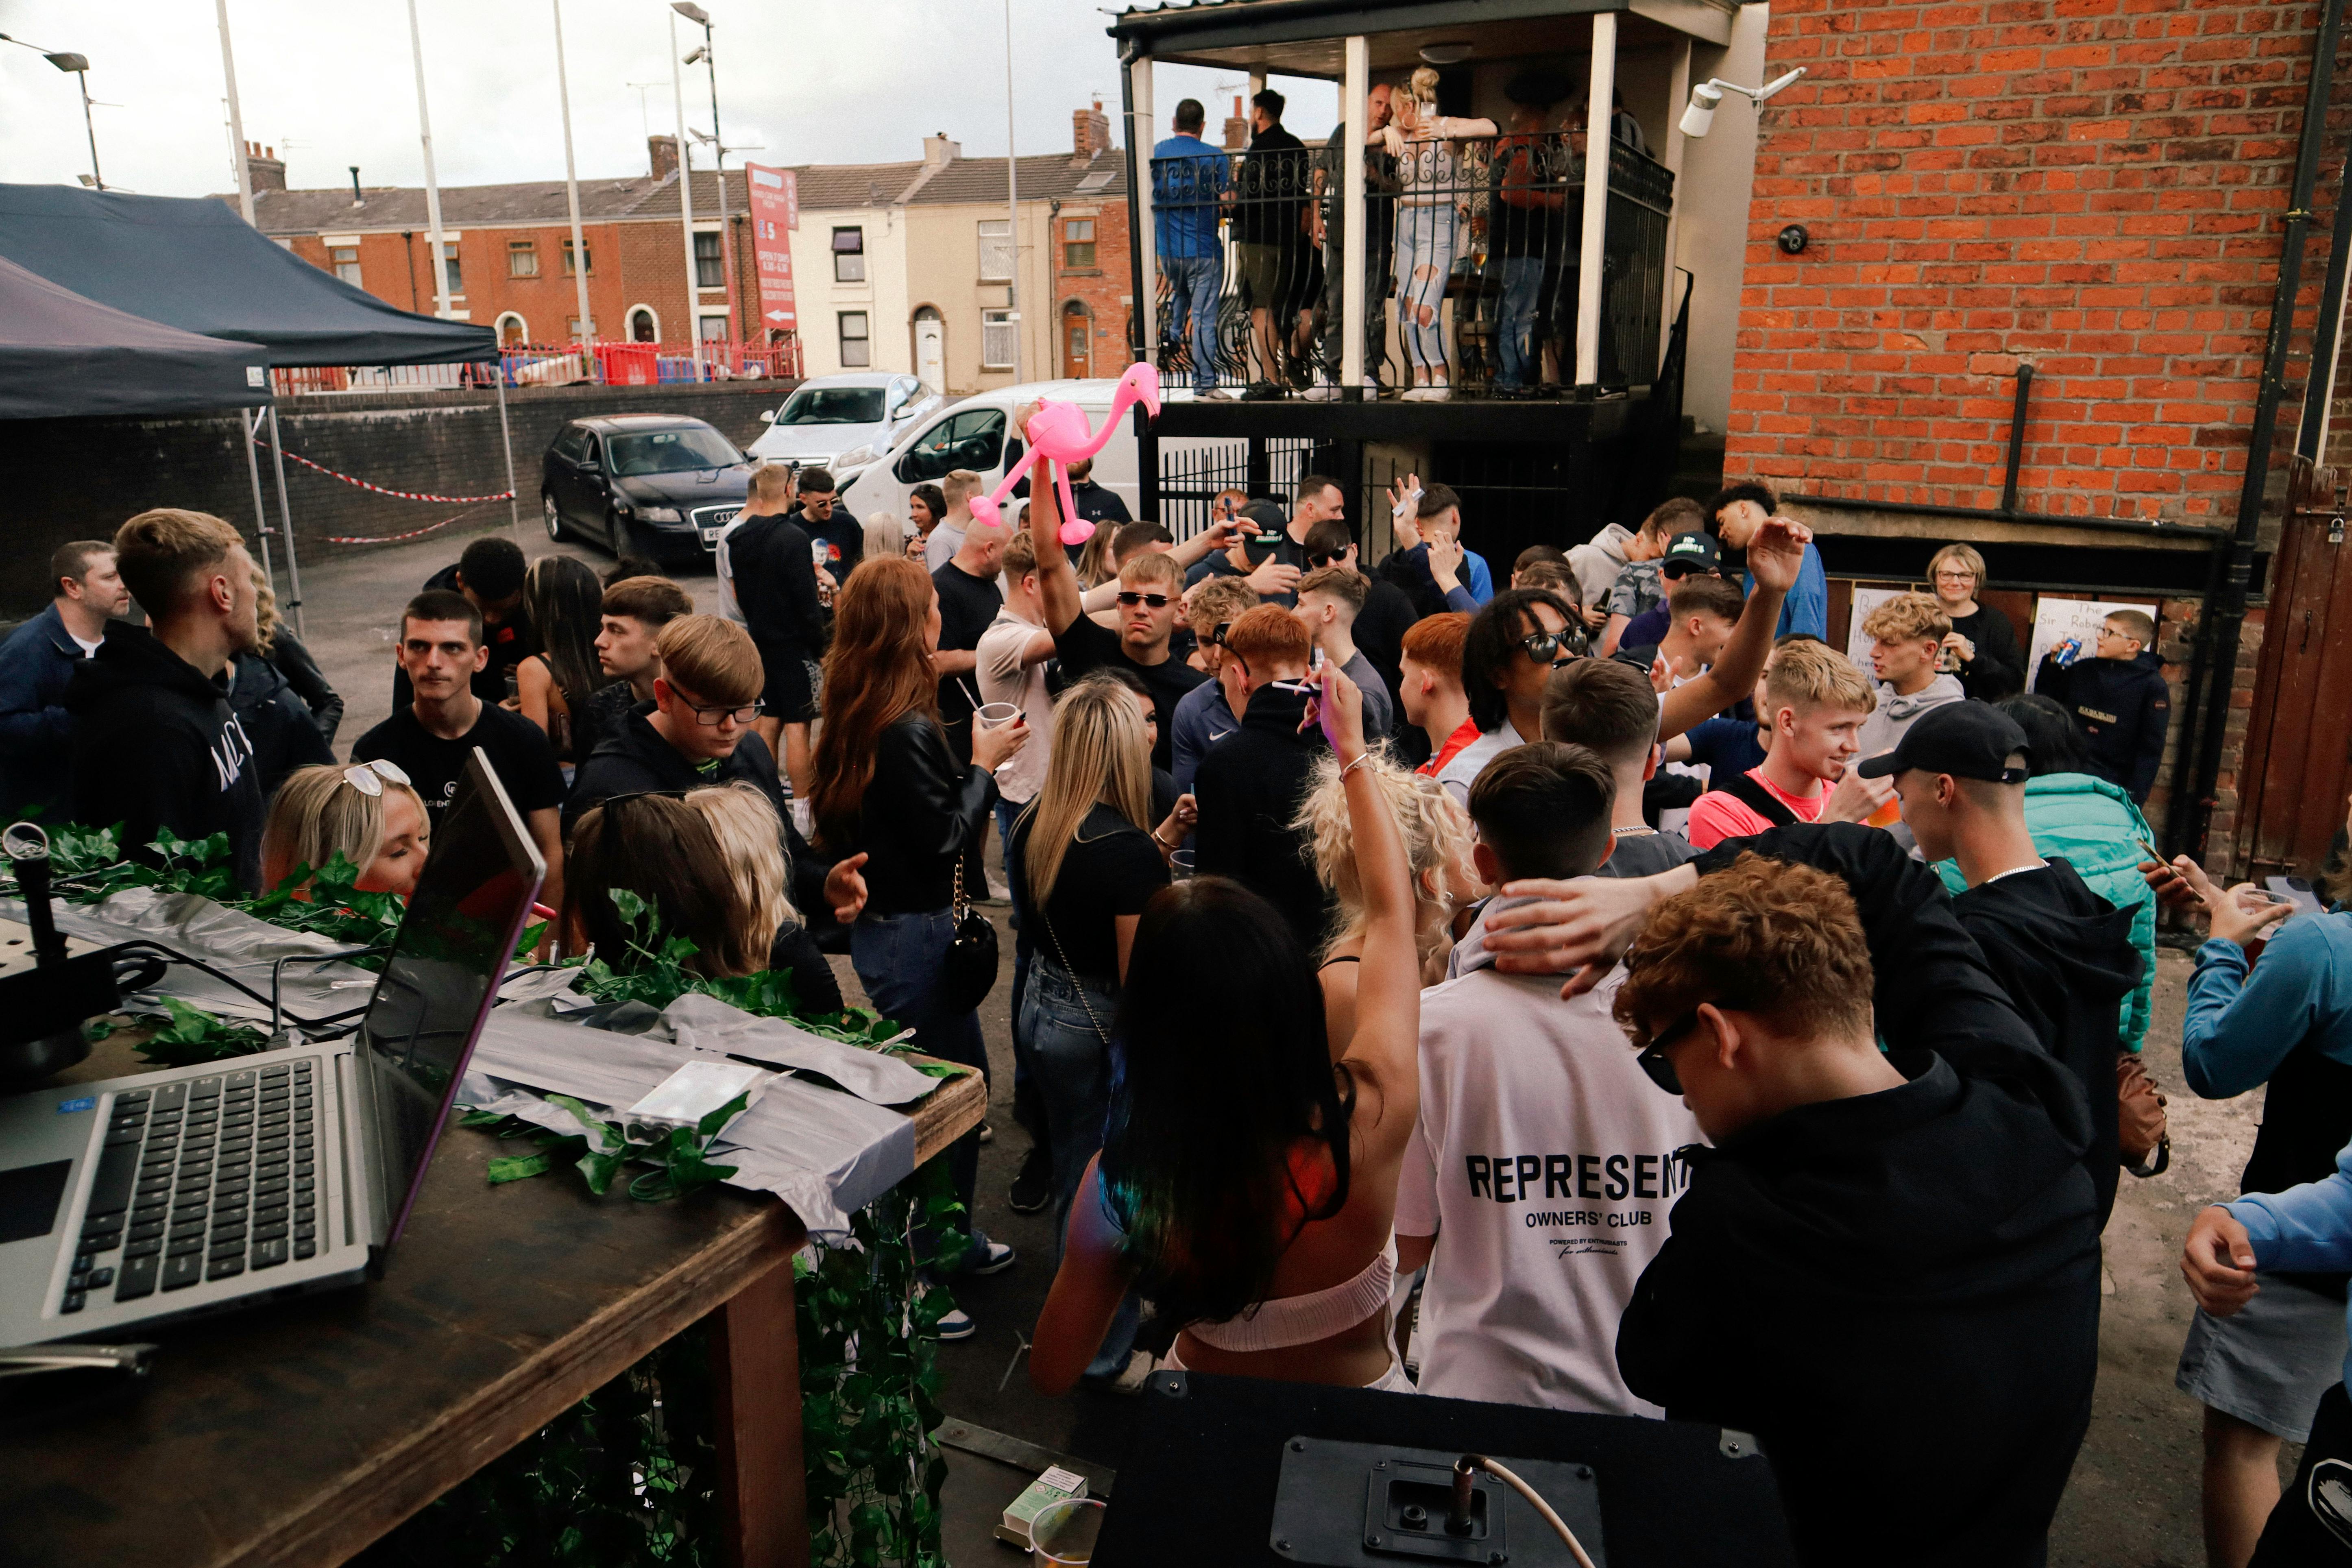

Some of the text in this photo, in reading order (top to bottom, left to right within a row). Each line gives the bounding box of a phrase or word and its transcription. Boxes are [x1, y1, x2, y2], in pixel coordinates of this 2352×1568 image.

[2077, 602, 2103, 615] The
[2040, 613, 2056, 625] Sir
[1607, 1211, 1652, 1228] CLUB
[1559, 1245, 1618, 1259] for enthusiasts
